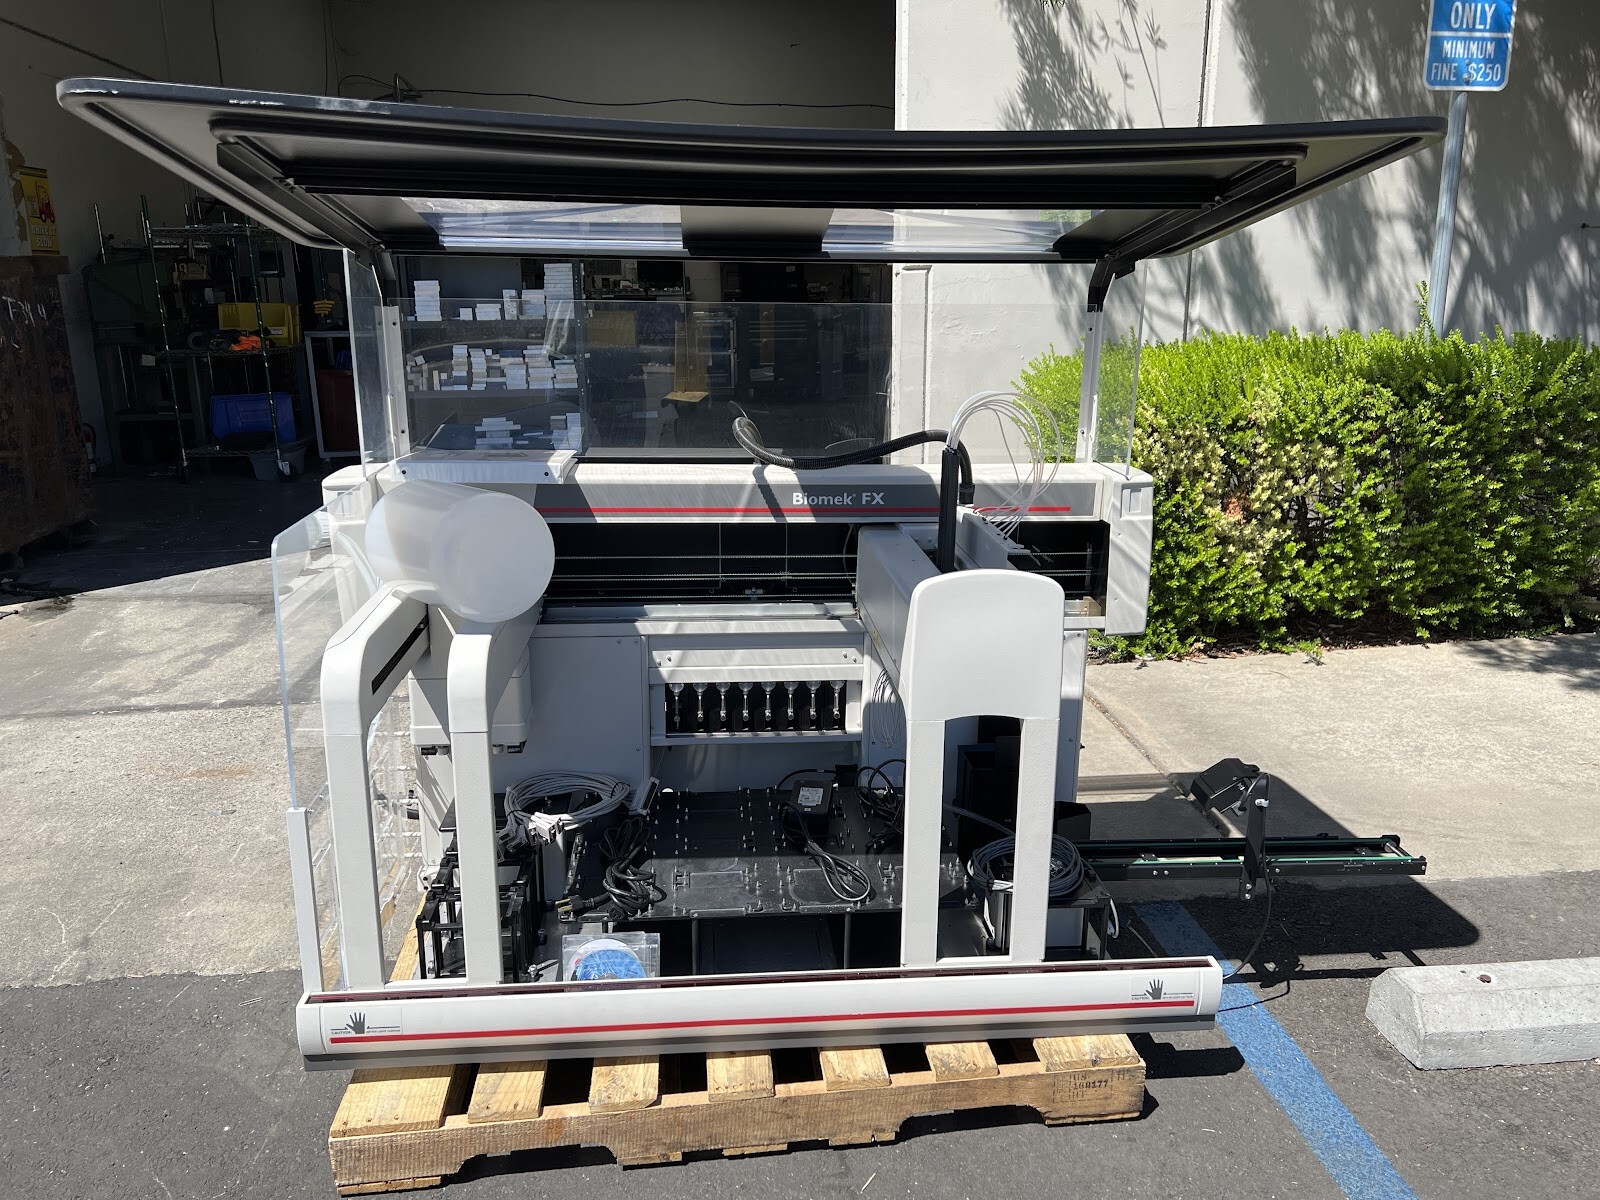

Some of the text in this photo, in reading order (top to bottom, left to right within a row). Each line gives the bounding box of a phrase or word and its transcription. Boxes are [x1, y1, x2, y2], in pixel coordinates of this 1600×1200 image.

[1451, 1, 1496, 30] ONLY
[1442, 40, 1495, 59] MINIMUM
[1431, 63, 1501, 82] FINE $250
[861, 492, 885, 505] FX
